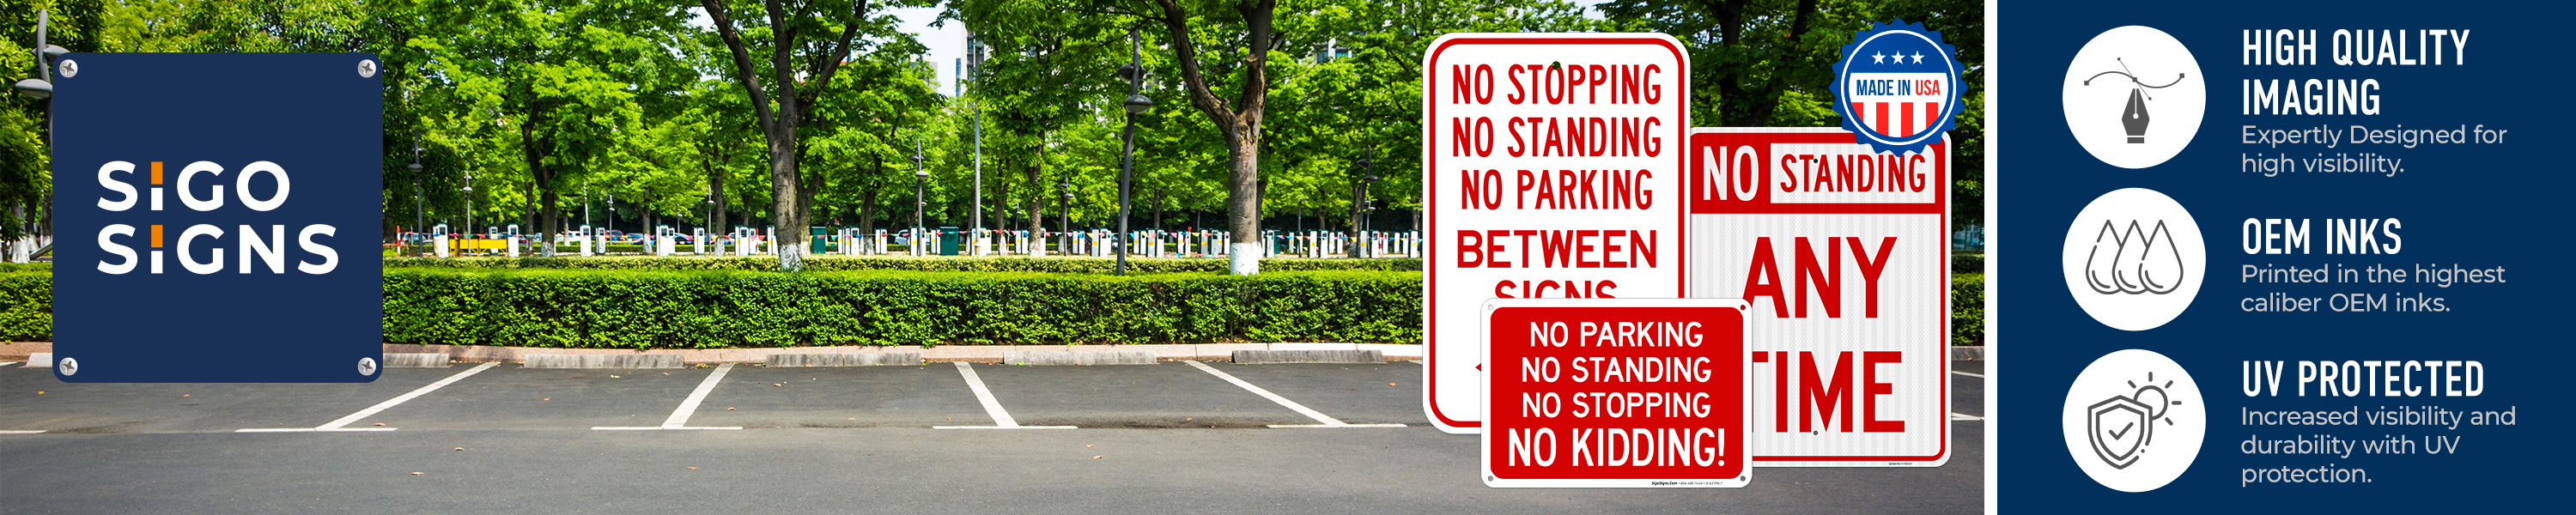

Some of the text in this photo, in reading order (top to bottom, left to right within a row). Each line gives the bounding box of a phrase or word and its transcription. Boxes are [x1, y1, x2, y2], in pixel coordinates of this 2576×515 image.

[1453, 64, 1662, 106] NO STOPPING
[1453, 116, 1662, 158] NO STANDING
[97, 161, 290, 212] SIGO
[1461, 168, 1653, 210] NO PARKING
[1703, 145, 1926, 202] NO STANDING
[97, 223, 339, 275] SIGNS
[1457, 229, 1657, 269] BETWEEN
[1742, 236, 1898, 318] ANY
[1530, 321, 1704, 348] NO PARKING
[1522, 356, 1712, 383] NO STANDING
[1522, 391, 1711, 418] NO STOPPING
[1509, 427, 1725, 467] NO KIDDING!
